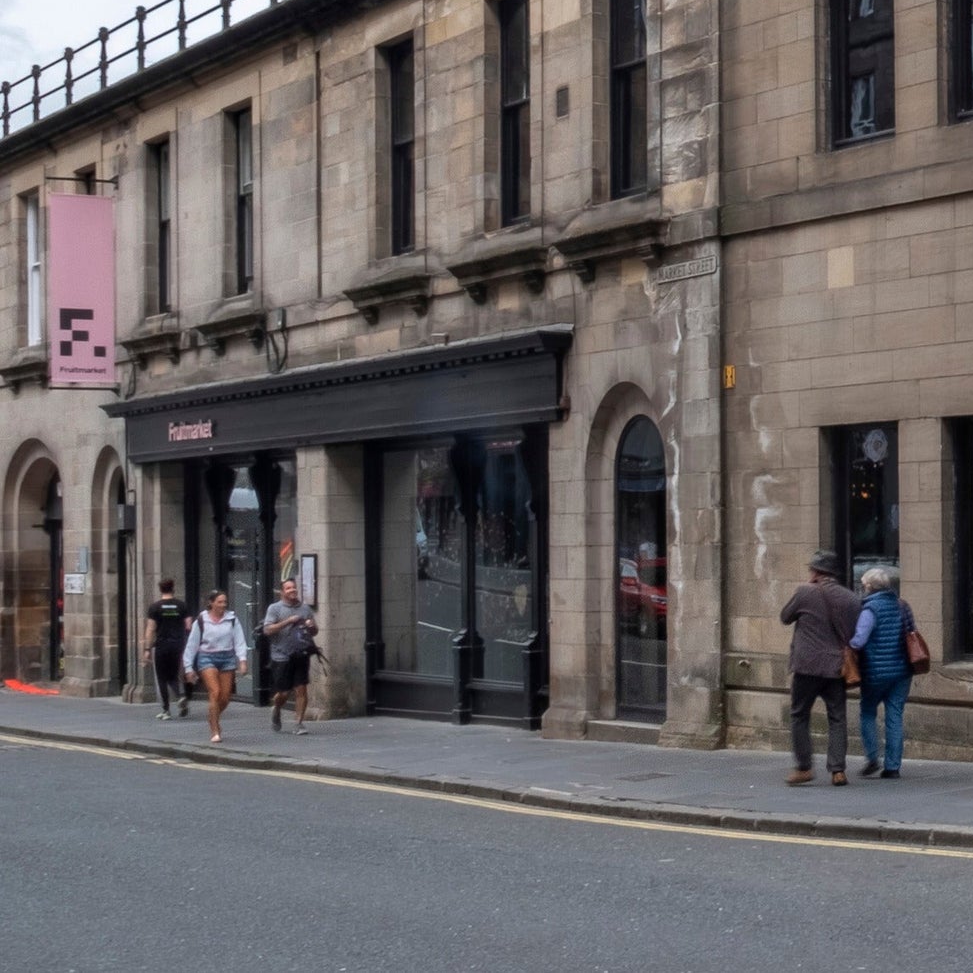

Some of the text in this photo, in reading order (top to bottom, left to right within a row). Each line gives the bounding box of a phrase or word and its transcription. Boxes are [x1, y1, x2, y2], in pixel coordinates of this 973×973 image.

[658, 258, 714, 280] MARKET STREET
[59, 366, 107, 374] Fruitmarket
